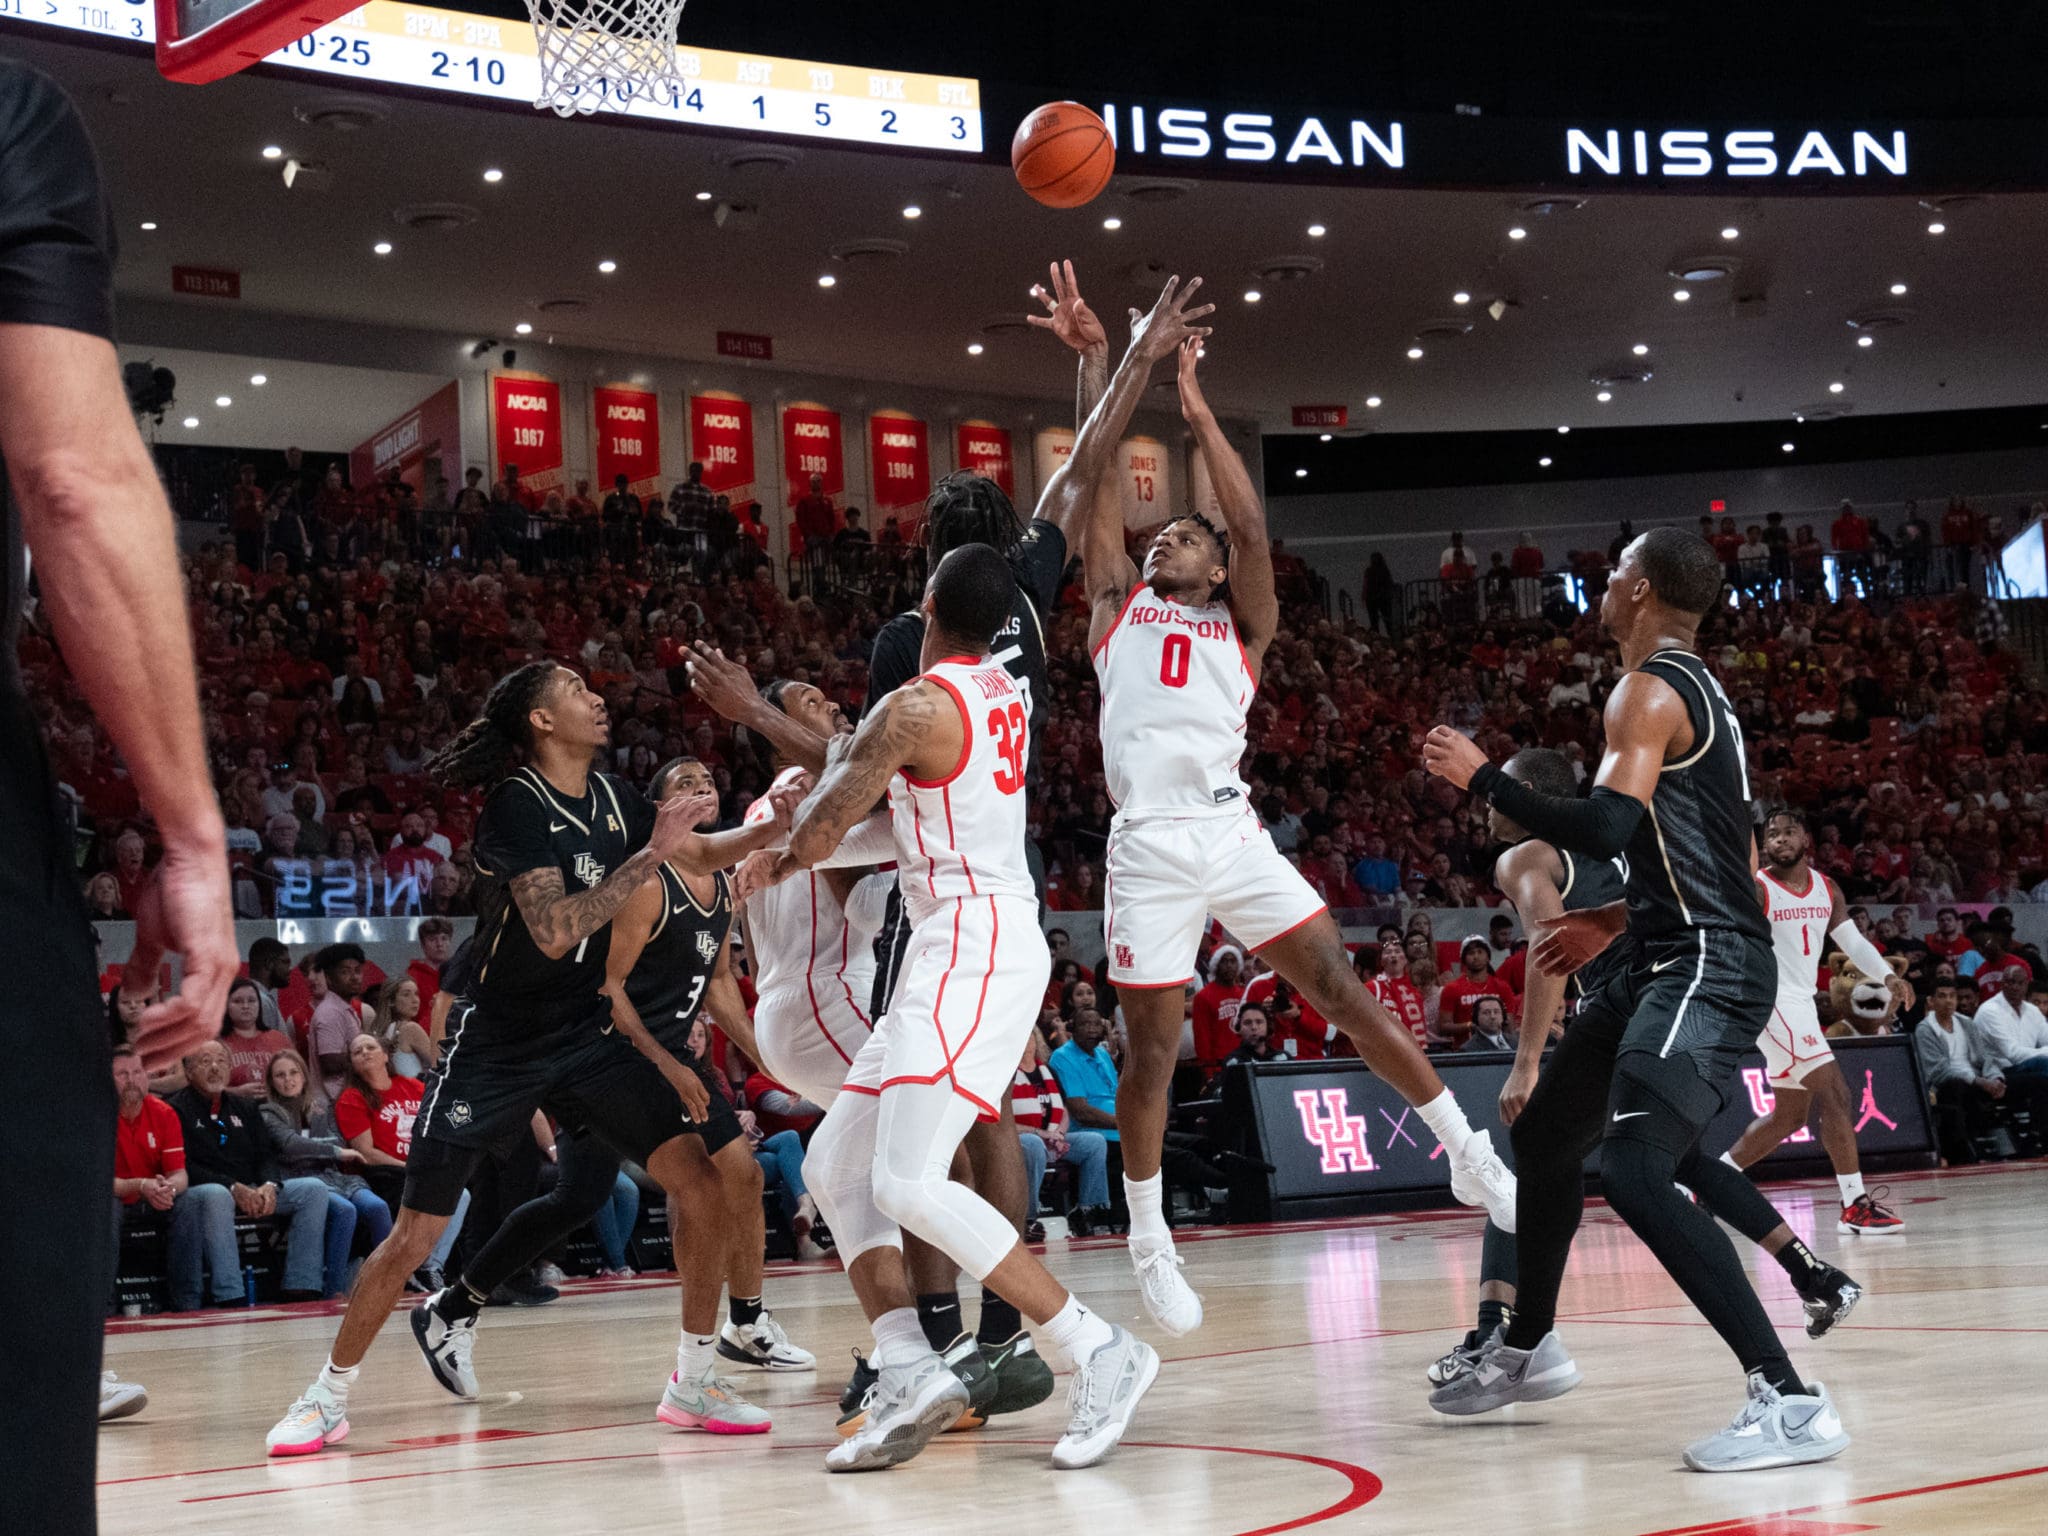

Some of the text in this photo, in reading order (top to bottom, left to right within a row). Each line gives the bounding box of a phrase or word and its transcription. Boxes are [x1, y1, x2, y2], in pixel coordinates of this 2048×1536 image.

[130, 18, 143, 37] 3
[405, 13, 449, 39] 3PM
[463, 21, 503, 48] 3PA
[431, 51, 505, 86] 2-10
[737, 62, 773, 84] AST
[808, 69, 834, 91] TO
[869, 76, 905, 99] BLK
[938, 83, 972, 105] STL
[752, 95, 765, 120] 1
[814, 102, 832, 127] 5
[881, 110, 899, 133] 2
[950, 116, 967, 140] 3
[1567, 129, 1908, 176] NISSAN
[507, 394, 548, 412] NCAA
[607, 405, 646, 422] NCAA
[703, 413, 741, 430] NCAA
[794, 422, 830, 439] NCAA
[514, 427, 545, 448] 1967
[882, 432, 918, 449] NCAA
[968, 440, 1002, 457] NCAA
[708, 445, 738, 464] 1982
[799, 454, 828, 474] 1983
[1128, 455, 1157, 472] JONES
[887, 461, 915, 480] 1984
[1133, 475, 1155, 502] 13
[1129, 606, 1229, 643] HOUSTON
[1159, 632, 1192, 689] 0
[987, 701, 1026, 796] 32
[1773, 905, 1831, 922] HOUSTON
[695, 931, 720, 965] UCF
[675, 974, 706, 1019] 3
